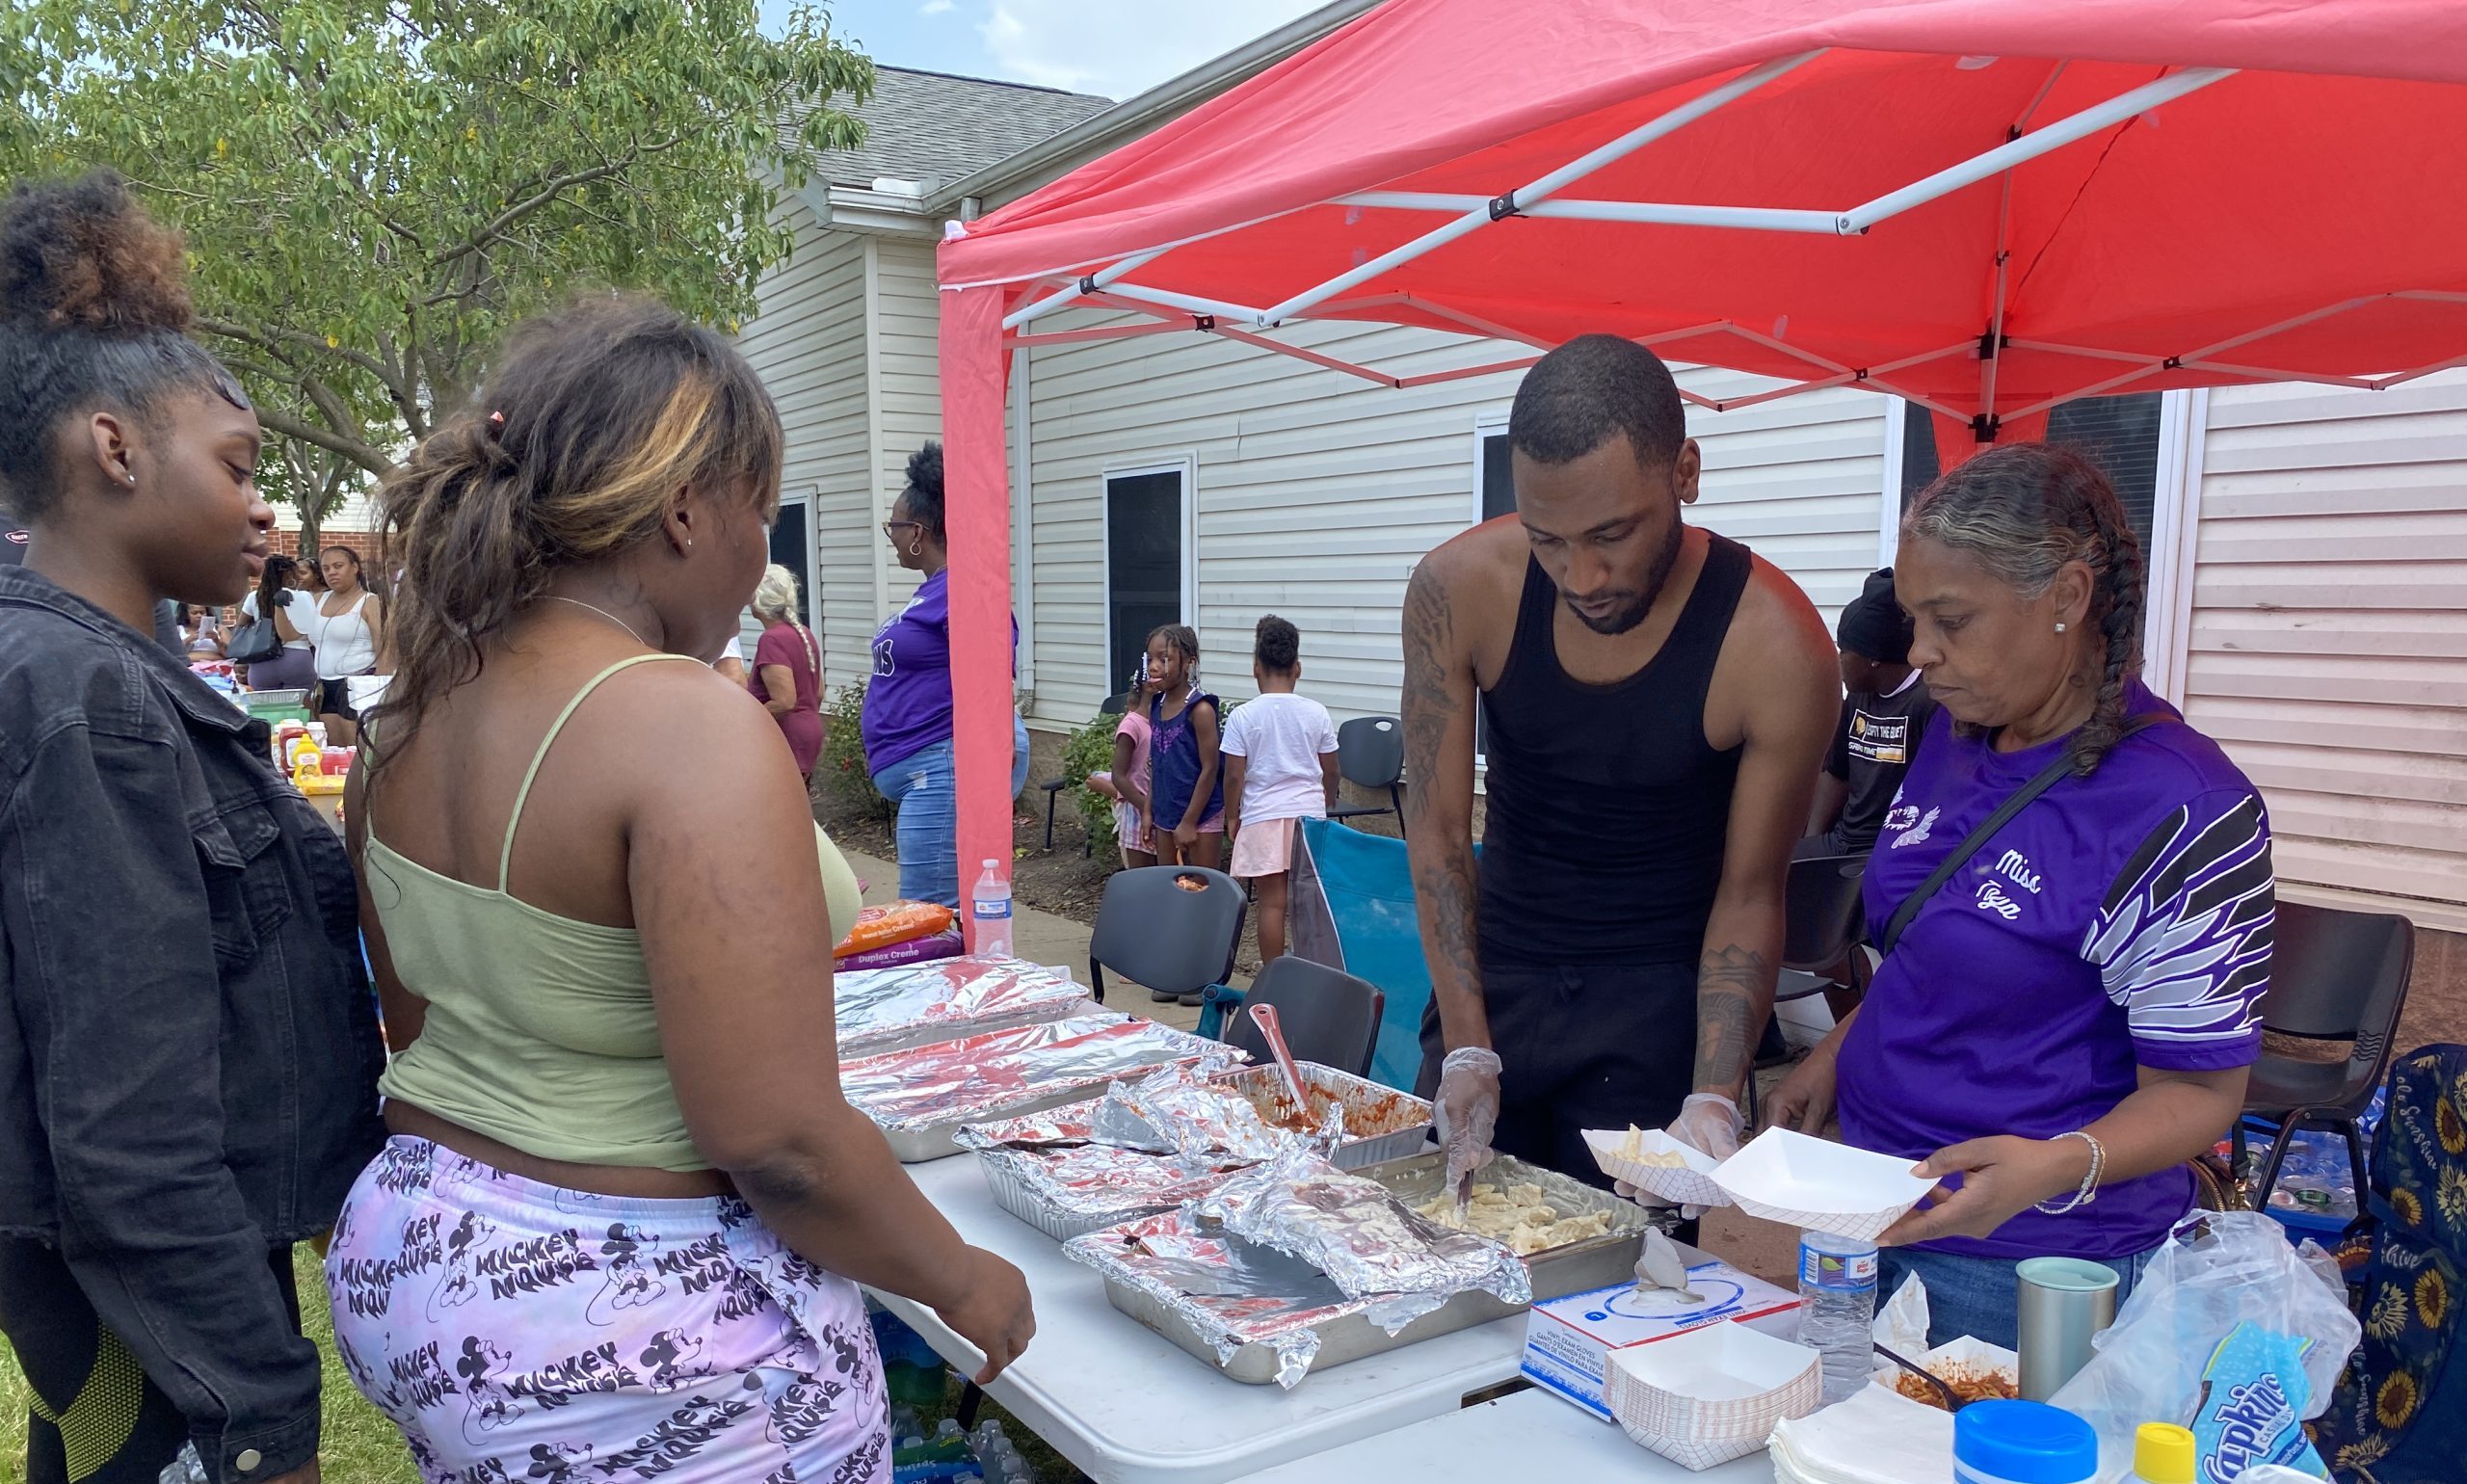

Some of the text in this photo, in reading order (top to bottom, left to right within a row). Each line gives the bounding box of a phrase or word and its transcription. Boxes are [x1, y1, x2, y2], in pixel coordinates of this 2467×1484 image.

[1995, 849, 2041, 894] Miss
[858, 953, 889, 964] Duplex
[890, 949, 919, 959] Creme
[475, 1228, 579, 1278] MICKEY
[490, 1252, 599, 1301] MOUSE
[1528, 1335, 1550, 1350] GUANTES
[1558, 1350, 1575, 1363] VINILO
[1575, 1359, 1588, 1370] PARA
[1536, 1332, 1552, 1343] GANTS
[1552, 1340, 1578, 1357] D'EXAMEN
[1586, 1358, 1604, 1371] VINYLE
[1547, 1330, 1560, 1341] VINYL
[1561, 1338, 1576, 1349] EXAM
[1577, 1344, 1595, 1359] GLOVES
[500, 1340, 620, 1399] MICKEY
[592, 1395, 721, 1477] MICKEY
[632, 1400, 756, 1479] MOUSE
